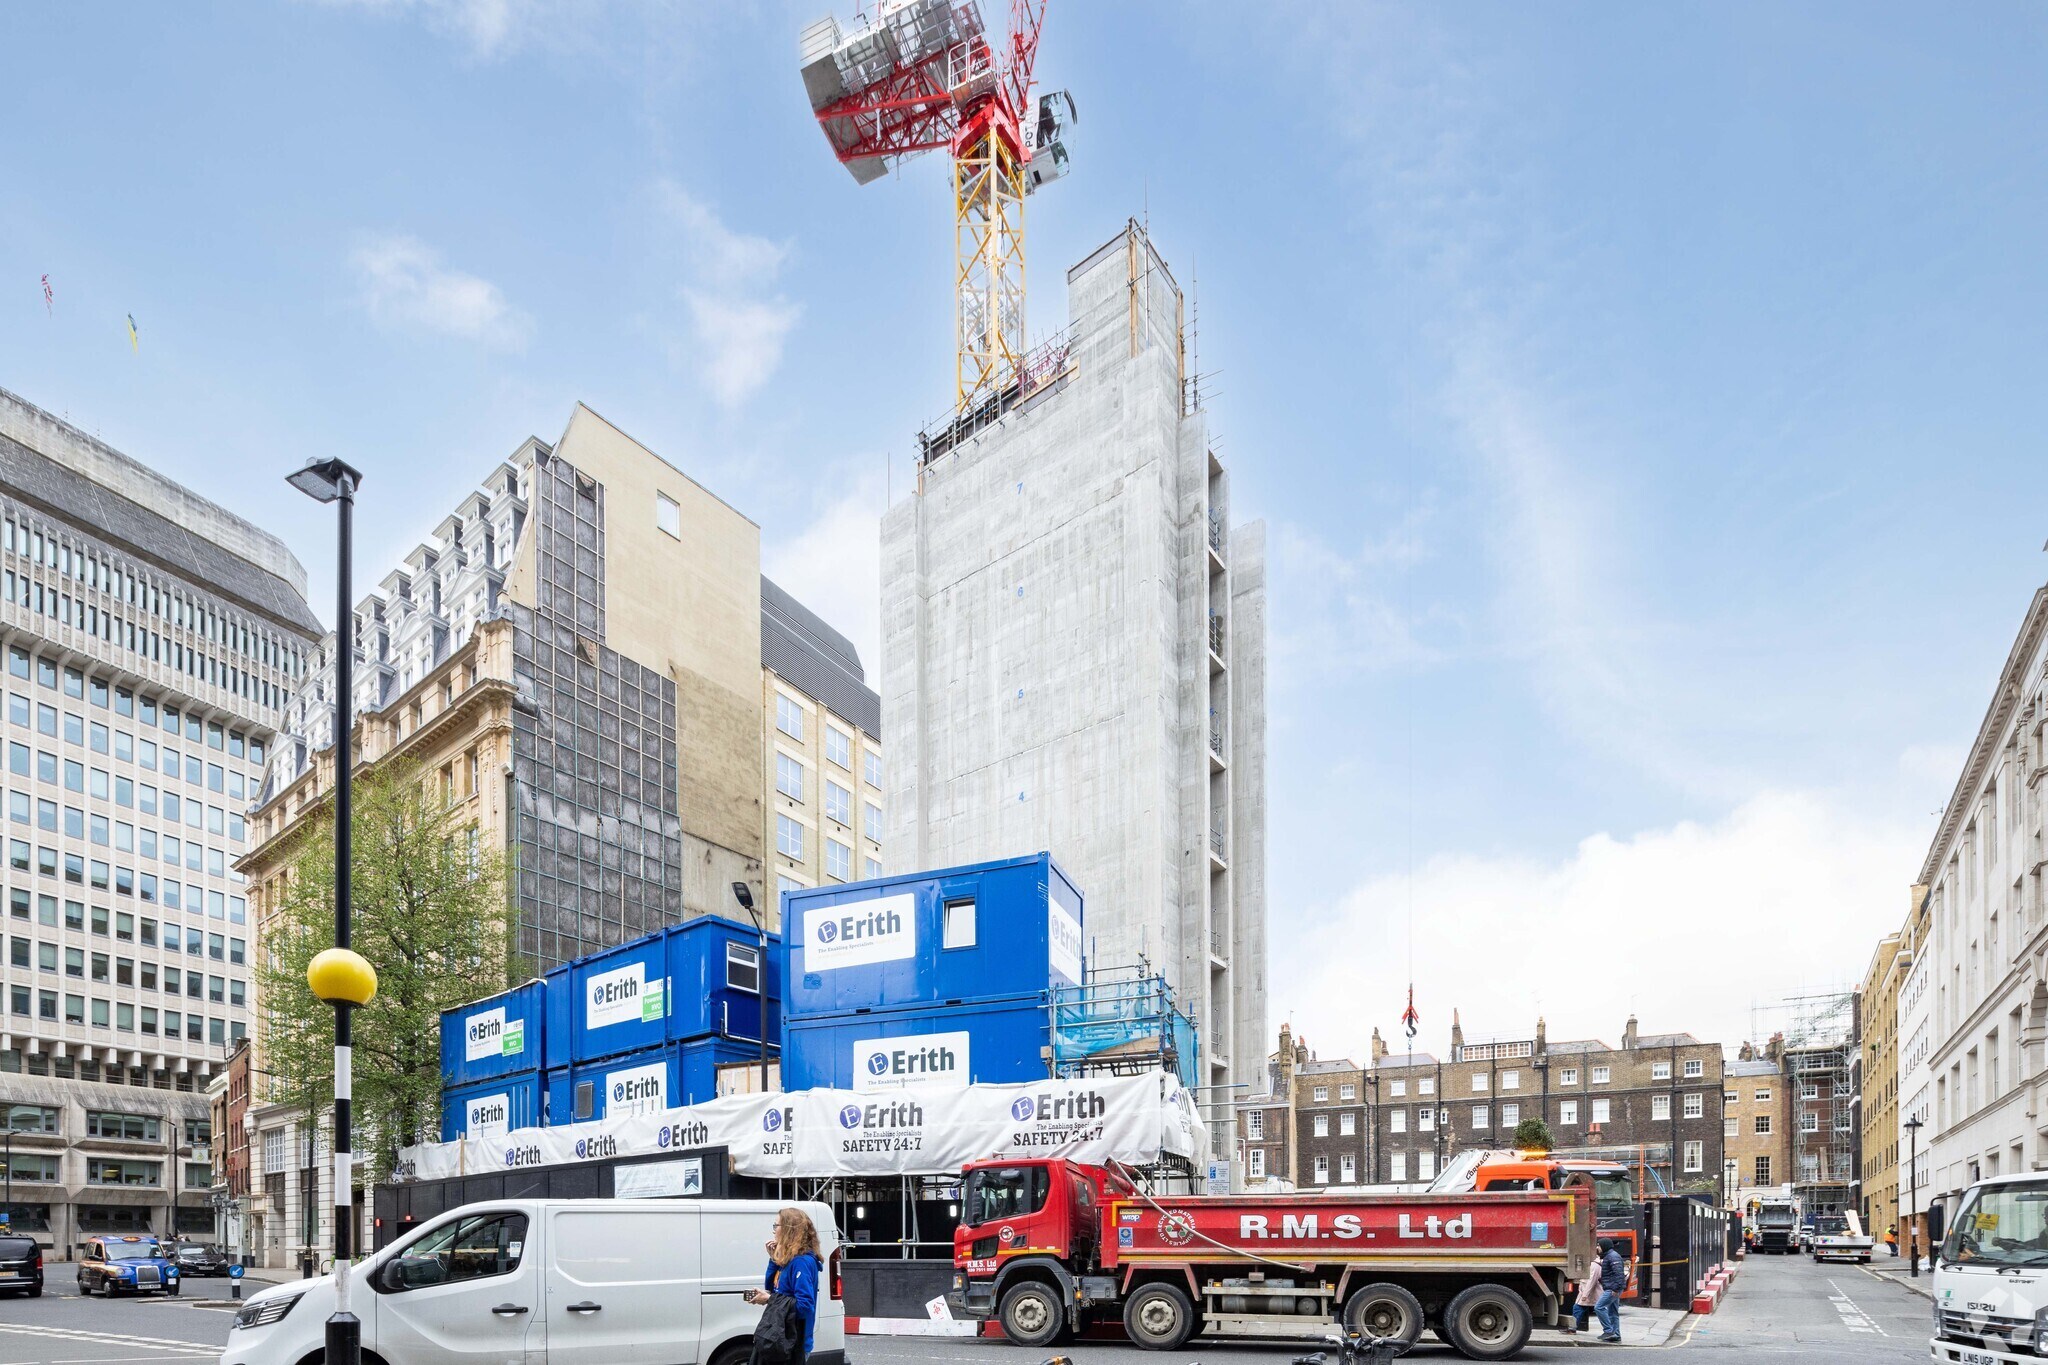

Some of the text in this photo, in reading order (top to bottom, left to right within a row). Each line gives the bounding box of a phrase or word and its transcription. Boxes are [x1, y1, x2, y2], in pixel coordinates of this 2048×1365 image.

[1017, 586, 1024, 597] 6
[1018, 688, 1024, 699] 5
[841, 910, 901, 941] Erith
[1060, 921, 1082, 962] Erith
[606, 977, 637, 1003] Erith
[478, 1019, 501, 1040] Erith
[892, 1047, 955, 1075] Erith
[626, 1076, 659, 1101] Erith
[480, 1104, 504, 1124] Erith
[863, 1101, 923, 1128] Erith
[1036, 1090, 1105, 1120] Erith
[672, 1121, 708, 1147] Erith
[873, 1130, 895, 1138] Enabling
[1013, 1127, 1104, 1146] SAFETY 24:7
[1048, 1122, 1073, 1131] Enabling
[515, 1145, 542, 1166] Erith
[587, 1135, 617, 1158] Erith
[843, 1138, 922, 1152] SAFETY 24:7
[1465, 1151, 1491, 1180] CORMACH
[1240, 1213, 1472, 1239] R.M.S. Ltd
[987, 1259, 997, 1267] Ltd
[1967, 1301, 1996, 1313] ISUZU
